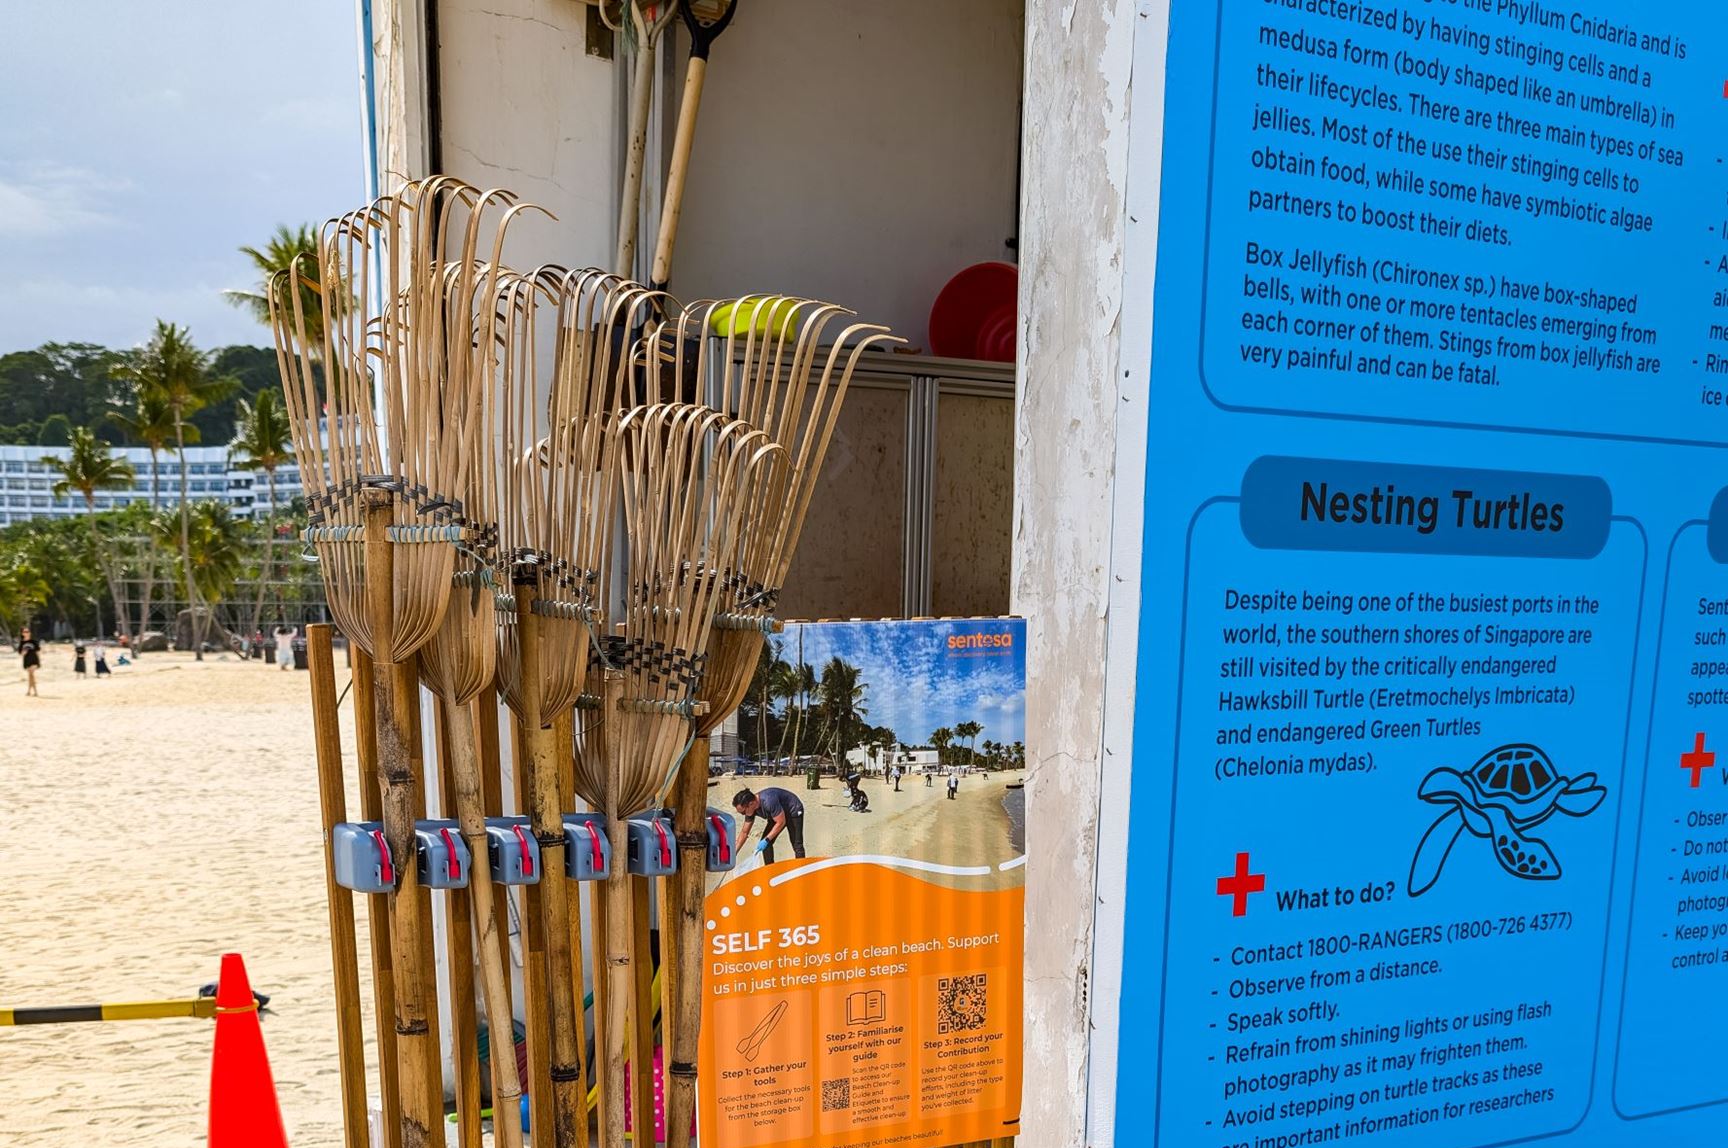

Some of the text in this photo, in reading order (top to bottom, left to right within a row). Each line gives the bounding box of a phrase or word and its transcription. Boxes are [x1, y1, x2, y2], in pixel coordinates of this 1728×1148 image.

[1498, 0, 1686, 59] Phyllum Cnidaria and is
[1259, 26, 1674, 129] medusa form (body shaped like an umbrella) in
[1246, 242, 1638, 314] Box Jellyfish (Chironex sp.) have box-shaped
[1240, 344, 1500, 386] very painful and can be fatal.
[1702, 385, 1722, 405] ice
[1300, 481, 1564, 535] Nesting Turtles
[1225, 589, 1599, 616] Despite being one of the busiest ports in the
[948, 632, 1012, 649] sentosa
[1223, 623, 1592, 648] world, the southern shores of Singapore are
[1694, 628, 1726, 646] such
[1220, 655, 1557, 680] still visited by the critically endangered
[1219, 685, 1575, 712] Hawksbill Turtle (Eretmochelys Imbricata)
[1216, 717, 1481, 745] and endangered Green Turtles
[1215, 752, 1377, 781] (Chelonia mydas).
[1684, 841, 1702, 857] Do
[1681, 867, 1719, 884] Avoid
[1276, 881, 1395, 912] What to do?
[712, 925, 820, 955] SELF 365
[1231, 912, 1572, 966] Contact 1800-RANGERS (1800-726 4377)
[1675, 924, 1709, 942] Keep
[713, 932, 1000, 976] Discover the joys of a clean beach. Support
[1671, 948, 1719, 970] control
[713, 962, 908, 995] us in just three simple steps:
[1229, 960, 1442, 999] Observe from a distance.
[1227, 1000, 1340, 1034] Speak softly.
[826, 1025, 904, 1042] Step 2: Familiarise
[923, 1033, 1004, 1049] Step 3: Record your
[1226, 1000, 1552, 1064] Refrain from shining lights or using flash
[828, 1038, 901, 1055] yourself with our
[853, 1051, 878, 1063] guide
[937, 1045, 990, 1058] Contribution
[722, 1062, 806, 1079] Step 1: Gather your
[754, 1076, 776, 1086] tools
[1224, 1037, 1527, 1100] photography as it may frighten them.
[1222, 1062, 1543, 1128] Avoid stepping on turtle tracks as these
[1345, 1107, 1439, 1138] information
[1443, 1102, 1466, 1120] for
[1469, 1088, 1554, 1115] researchers
